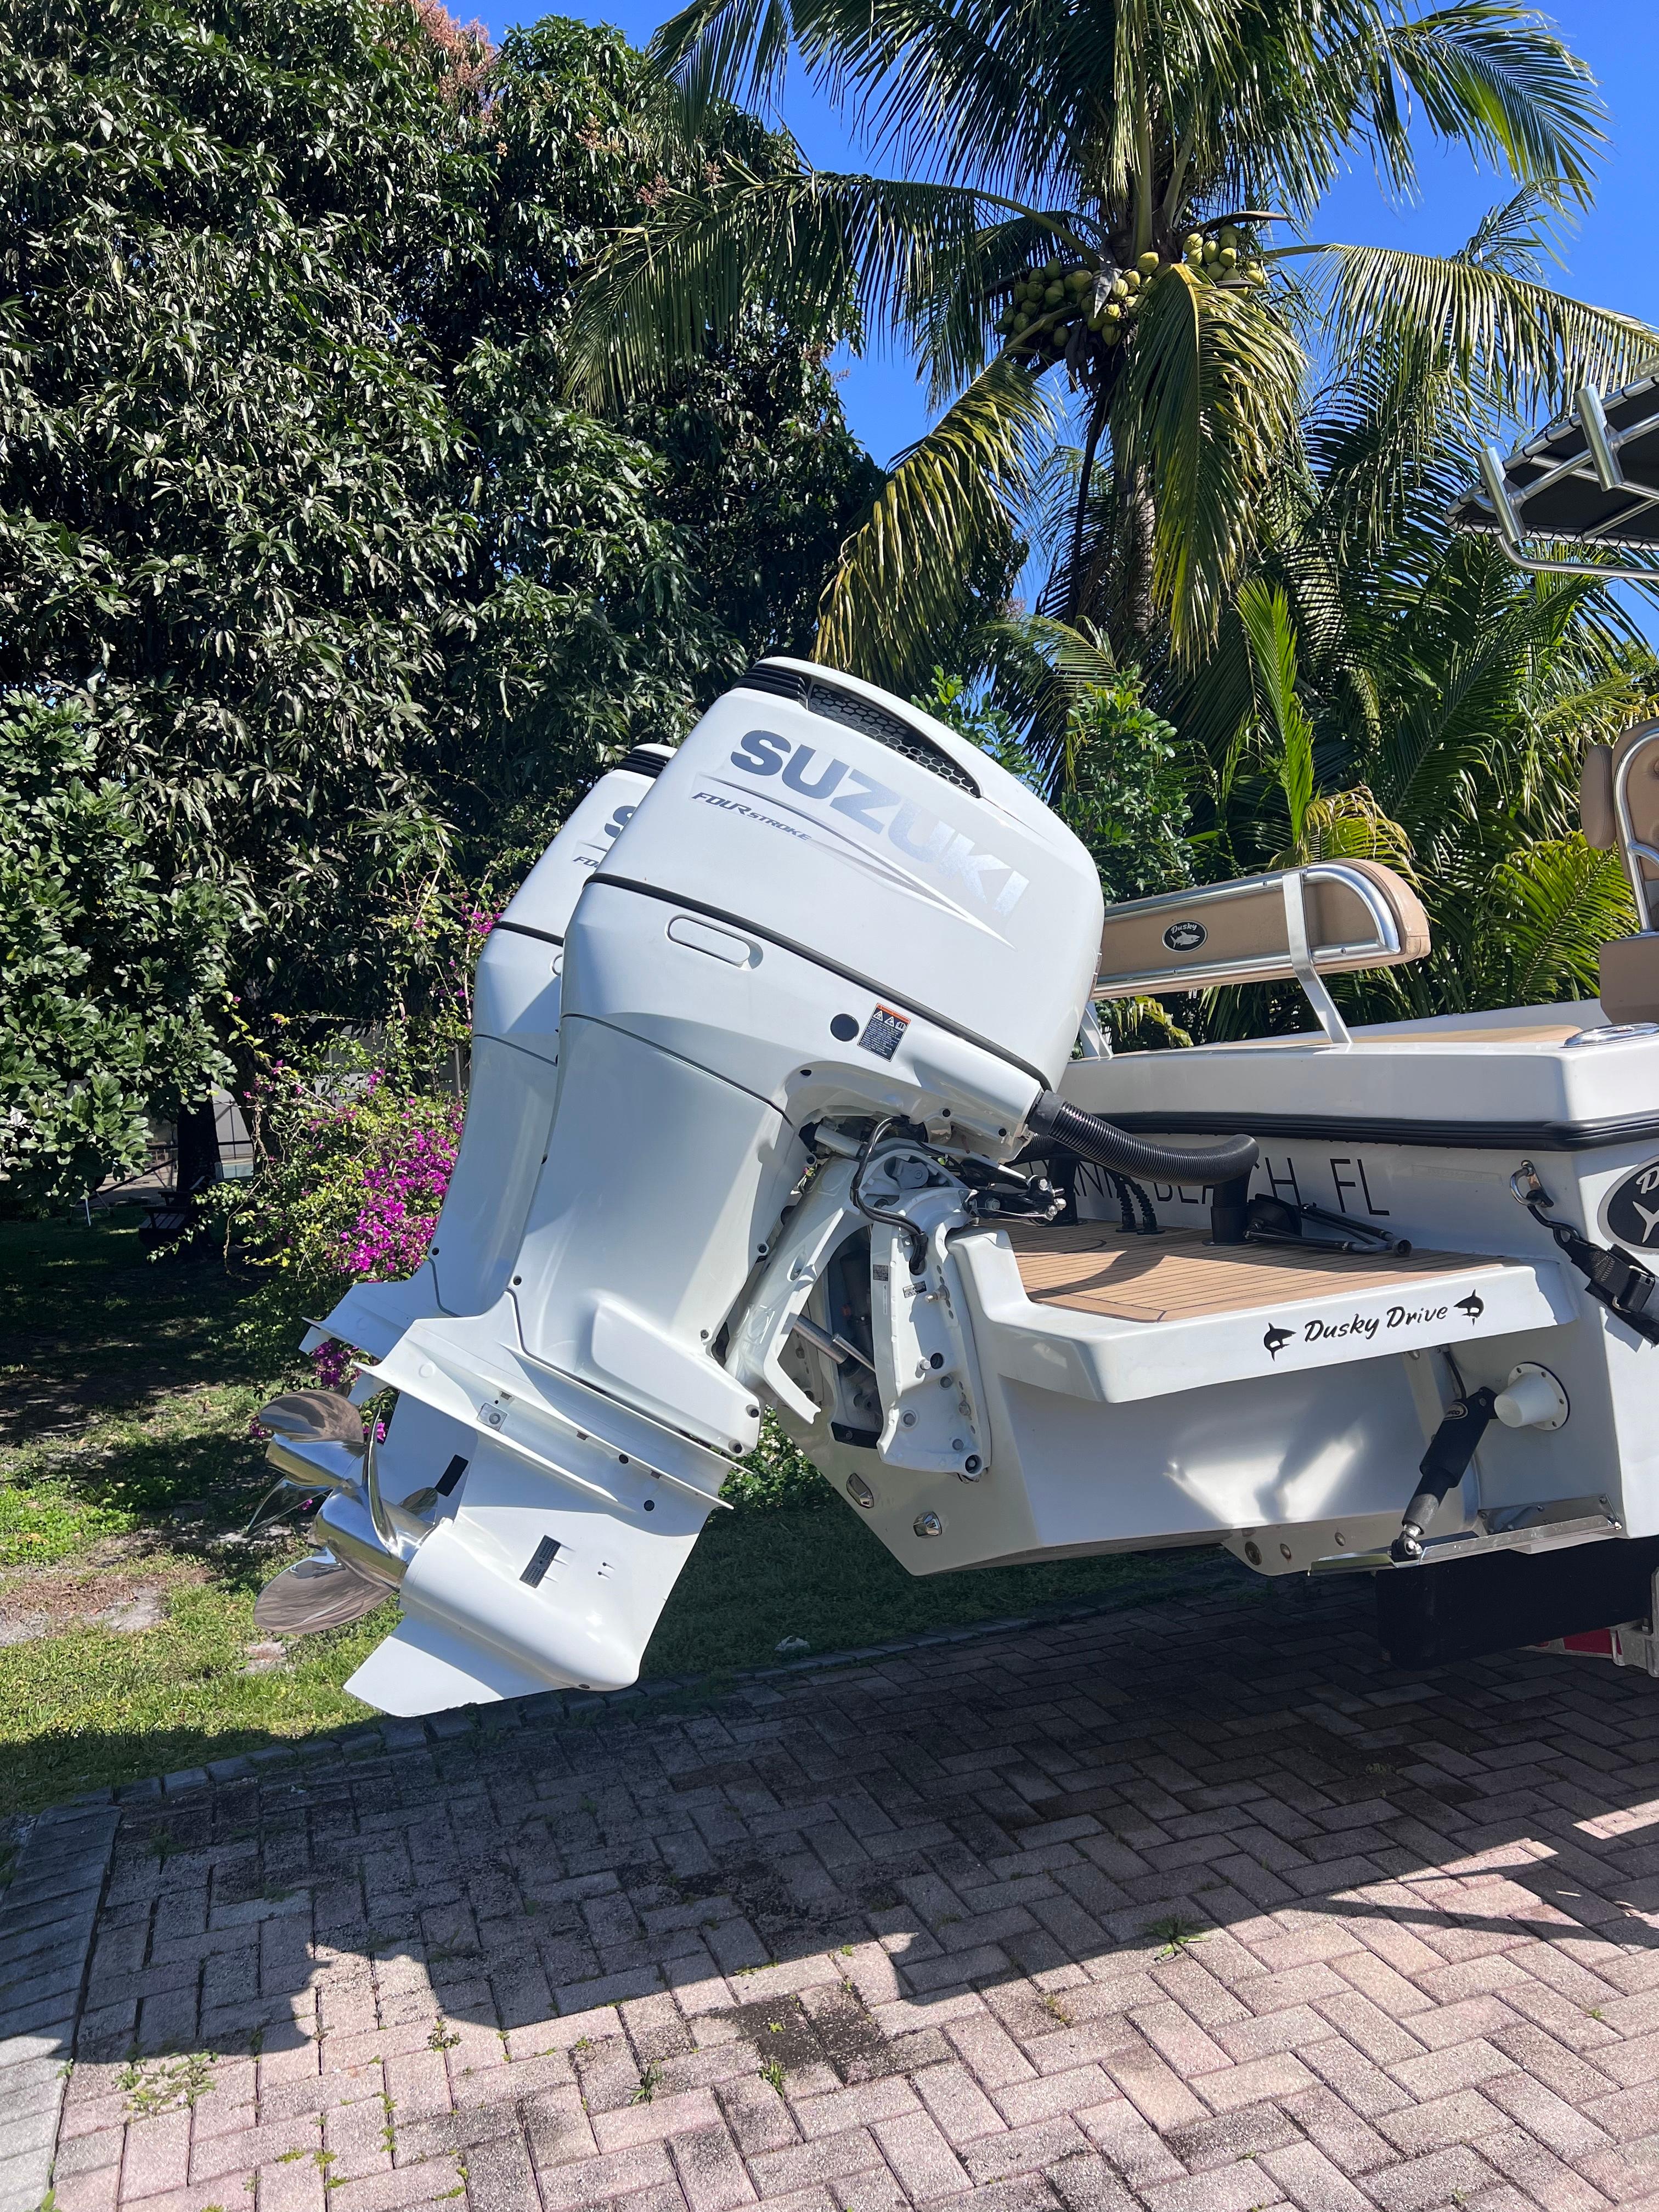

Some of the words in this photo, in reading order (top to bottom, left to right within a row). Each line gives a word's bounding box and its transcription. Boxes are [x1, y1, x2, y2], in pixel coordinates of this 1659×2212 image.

[730, 730, 1030, 916] SUZUKI
[1170, 923, 1197, 934] Dusky
[1329, 1158, 1391, 1216] FL
[1304, 1313, 1380, 1343] Dusky
[1386, 1306, 1449, 1328] Drive
